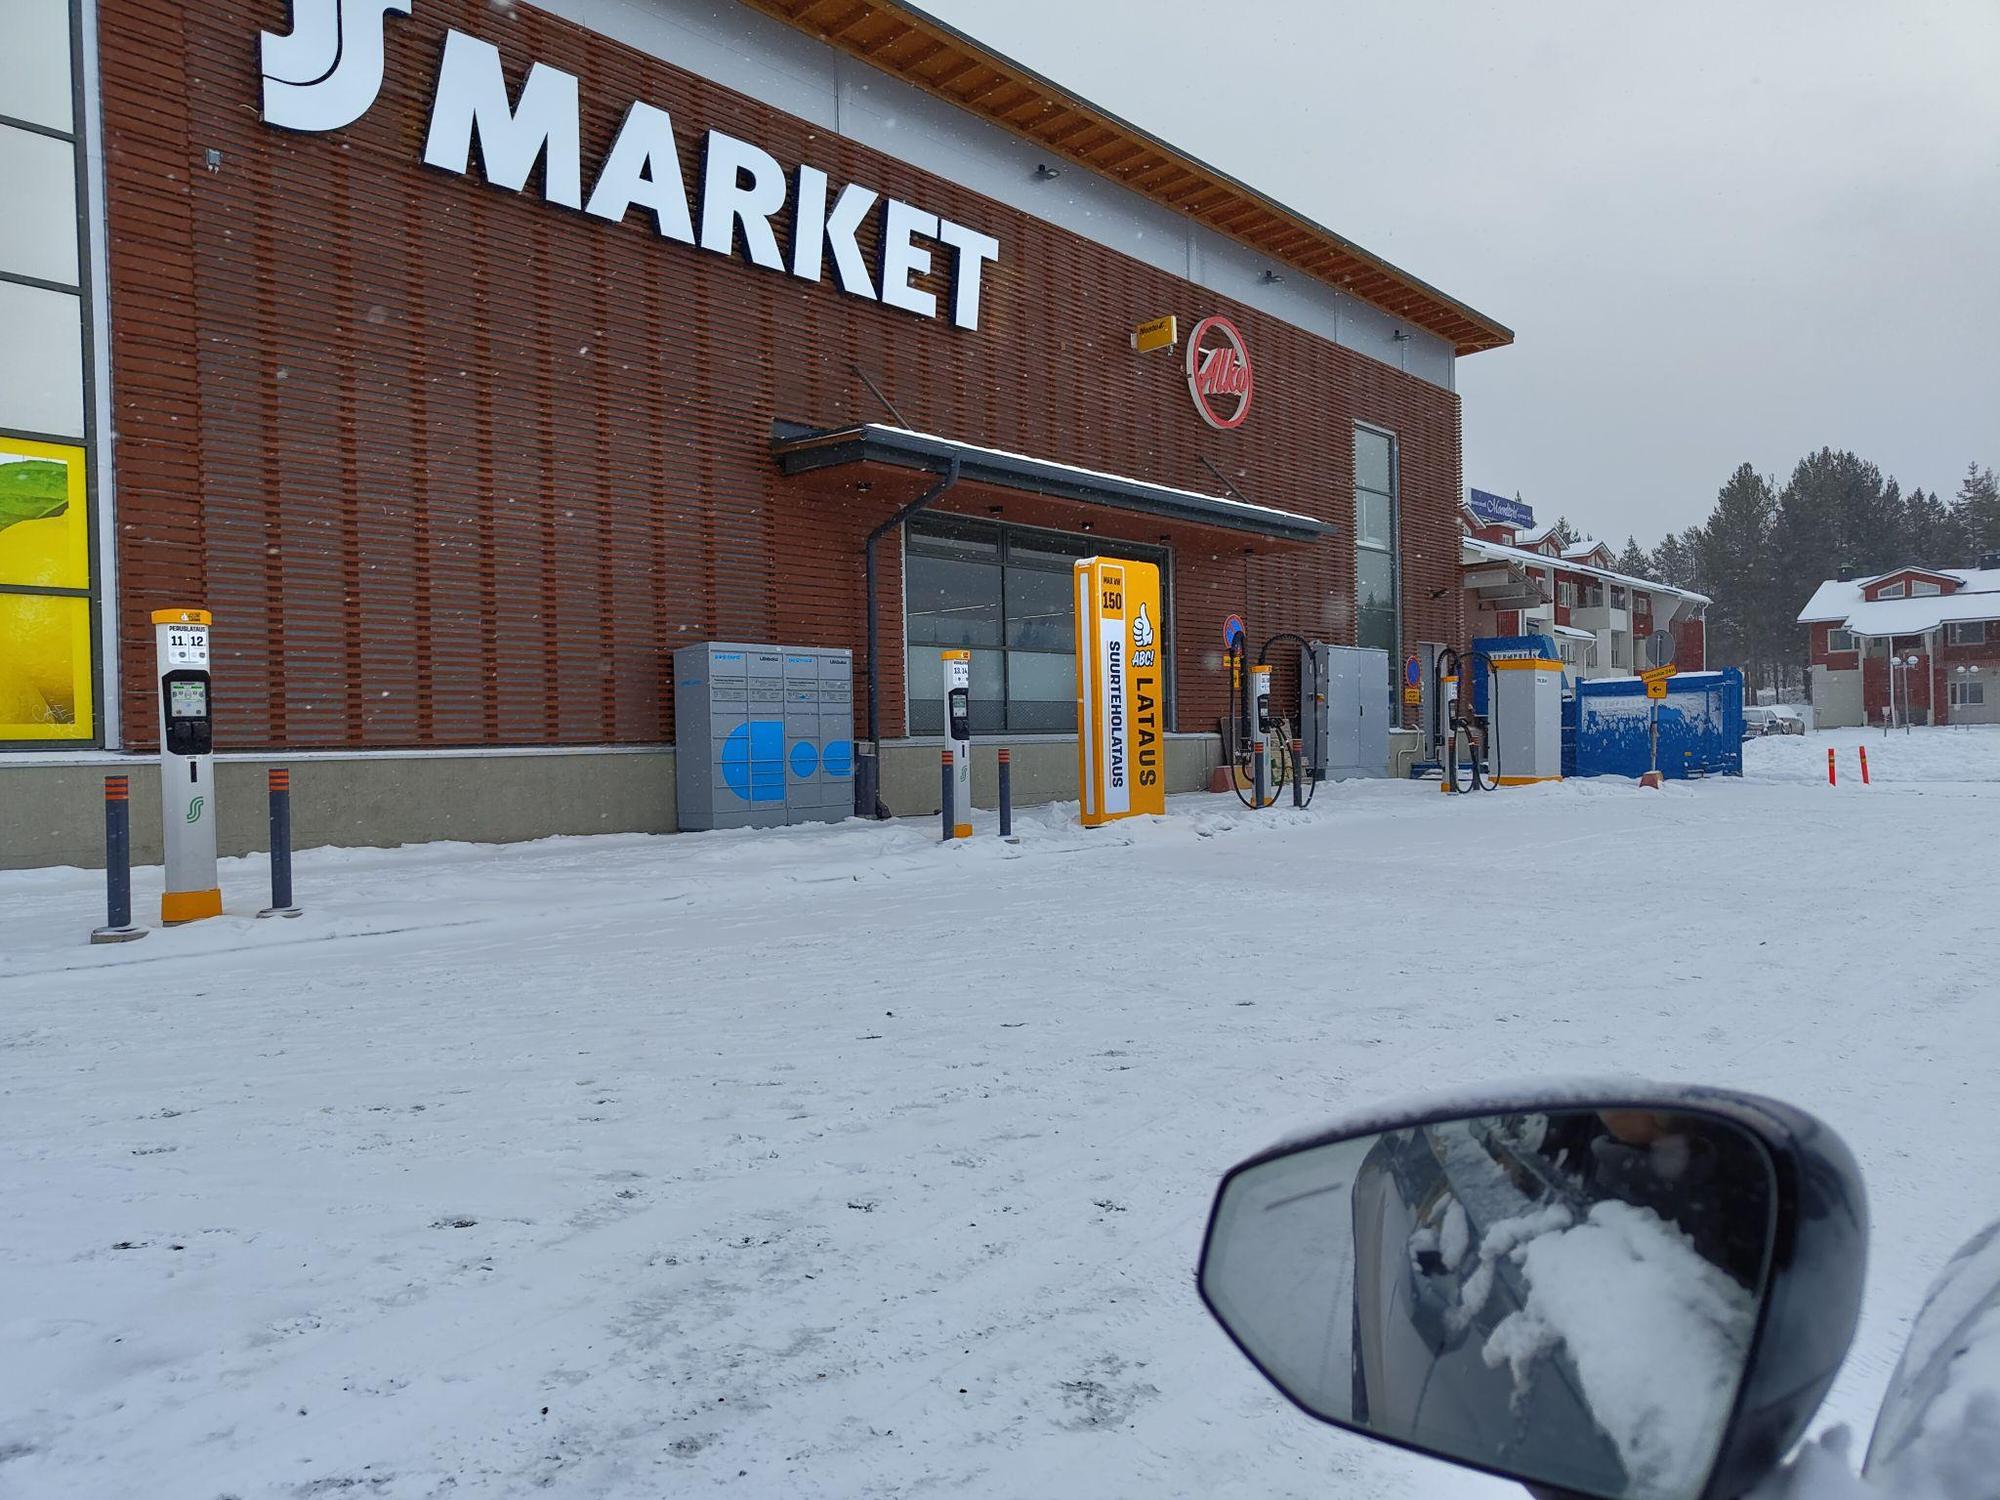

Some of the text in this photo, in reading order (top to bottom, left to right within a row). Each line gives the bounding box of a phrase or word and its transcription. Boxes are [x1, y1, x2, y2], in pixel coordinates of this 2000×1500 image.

[422, 28, 999, 332] MARKET
[1103, 591, 1122, 610] 150
[1132, 650, 1155, 667] ABC!
[1109, 641, 1123, 788] SUURTEHOLATAUS
[1136, 677, 1157, 786] LATAUS
